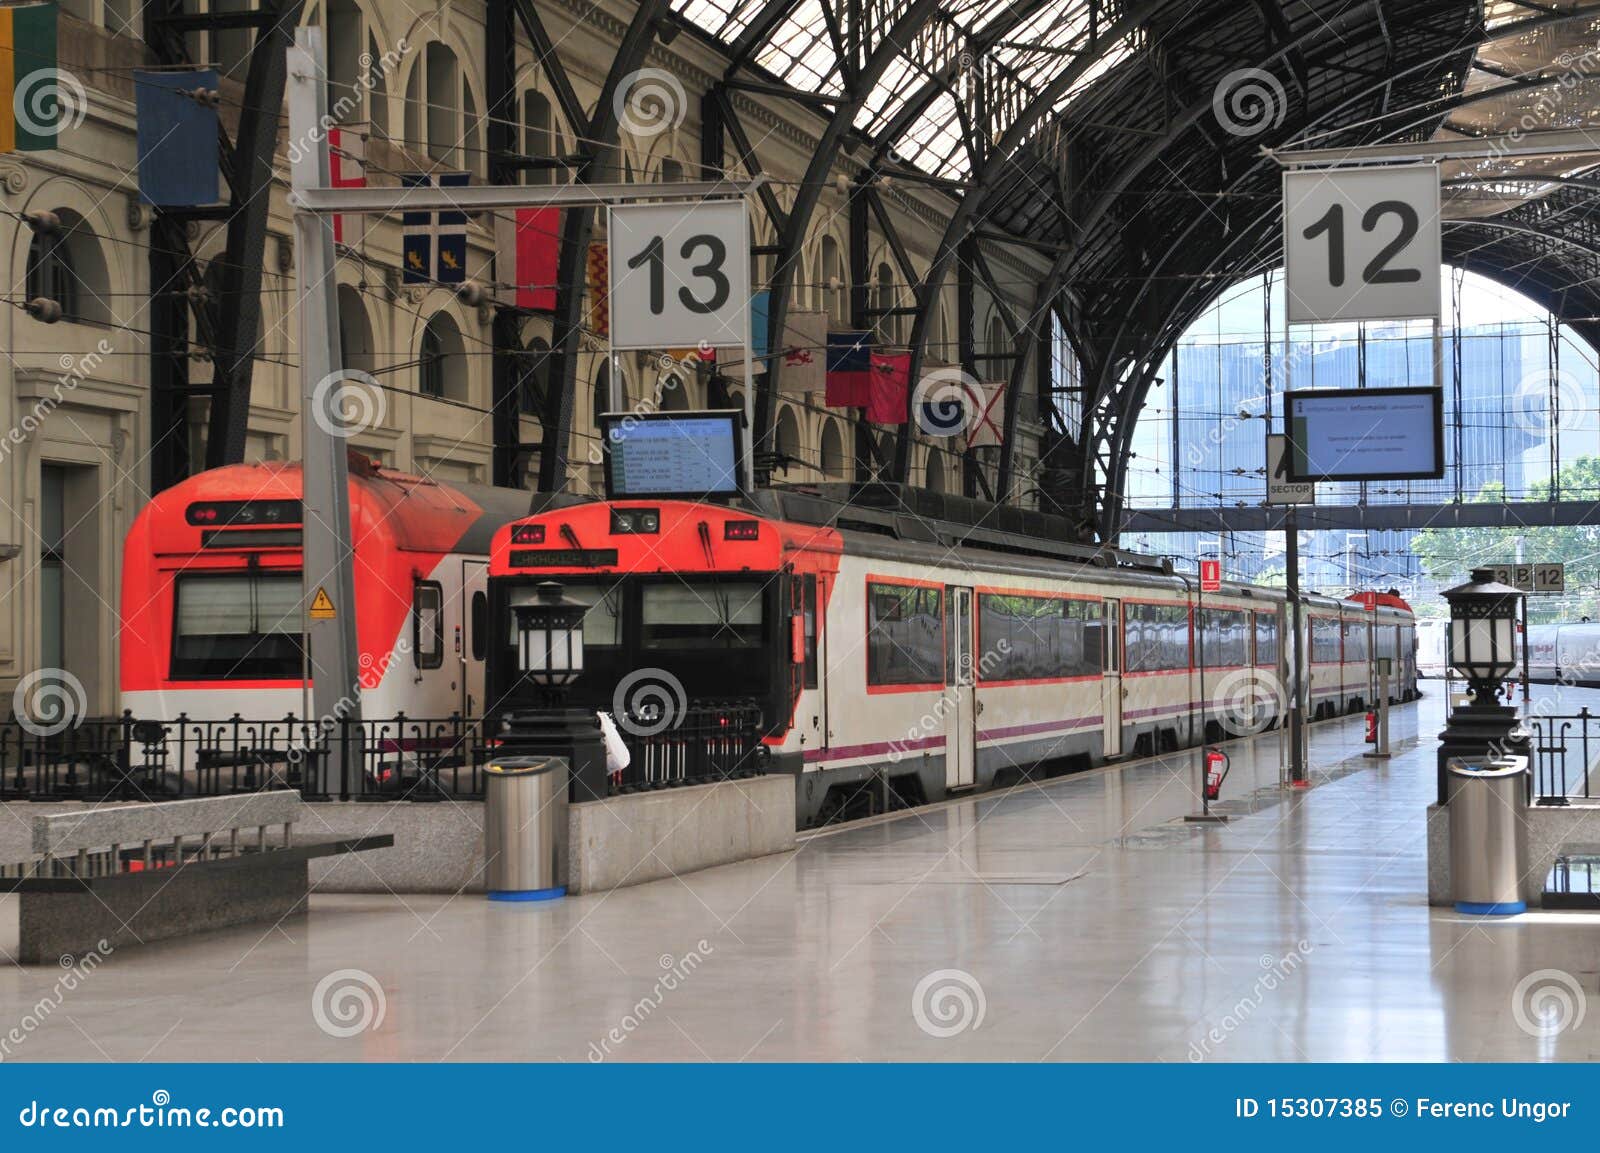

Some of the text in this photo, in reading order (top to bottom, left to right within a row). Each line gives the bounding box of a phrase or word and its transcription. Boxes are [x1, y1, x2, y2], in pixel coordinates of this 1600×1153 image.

[1303, 201, 1422, 288] 12
[628, 235, 730, 315] 13
[1270, 485, 1310, 494] SECTOR
[1517, 568, 1529, 583] B
[1538, 569, 1560, 585] 12
